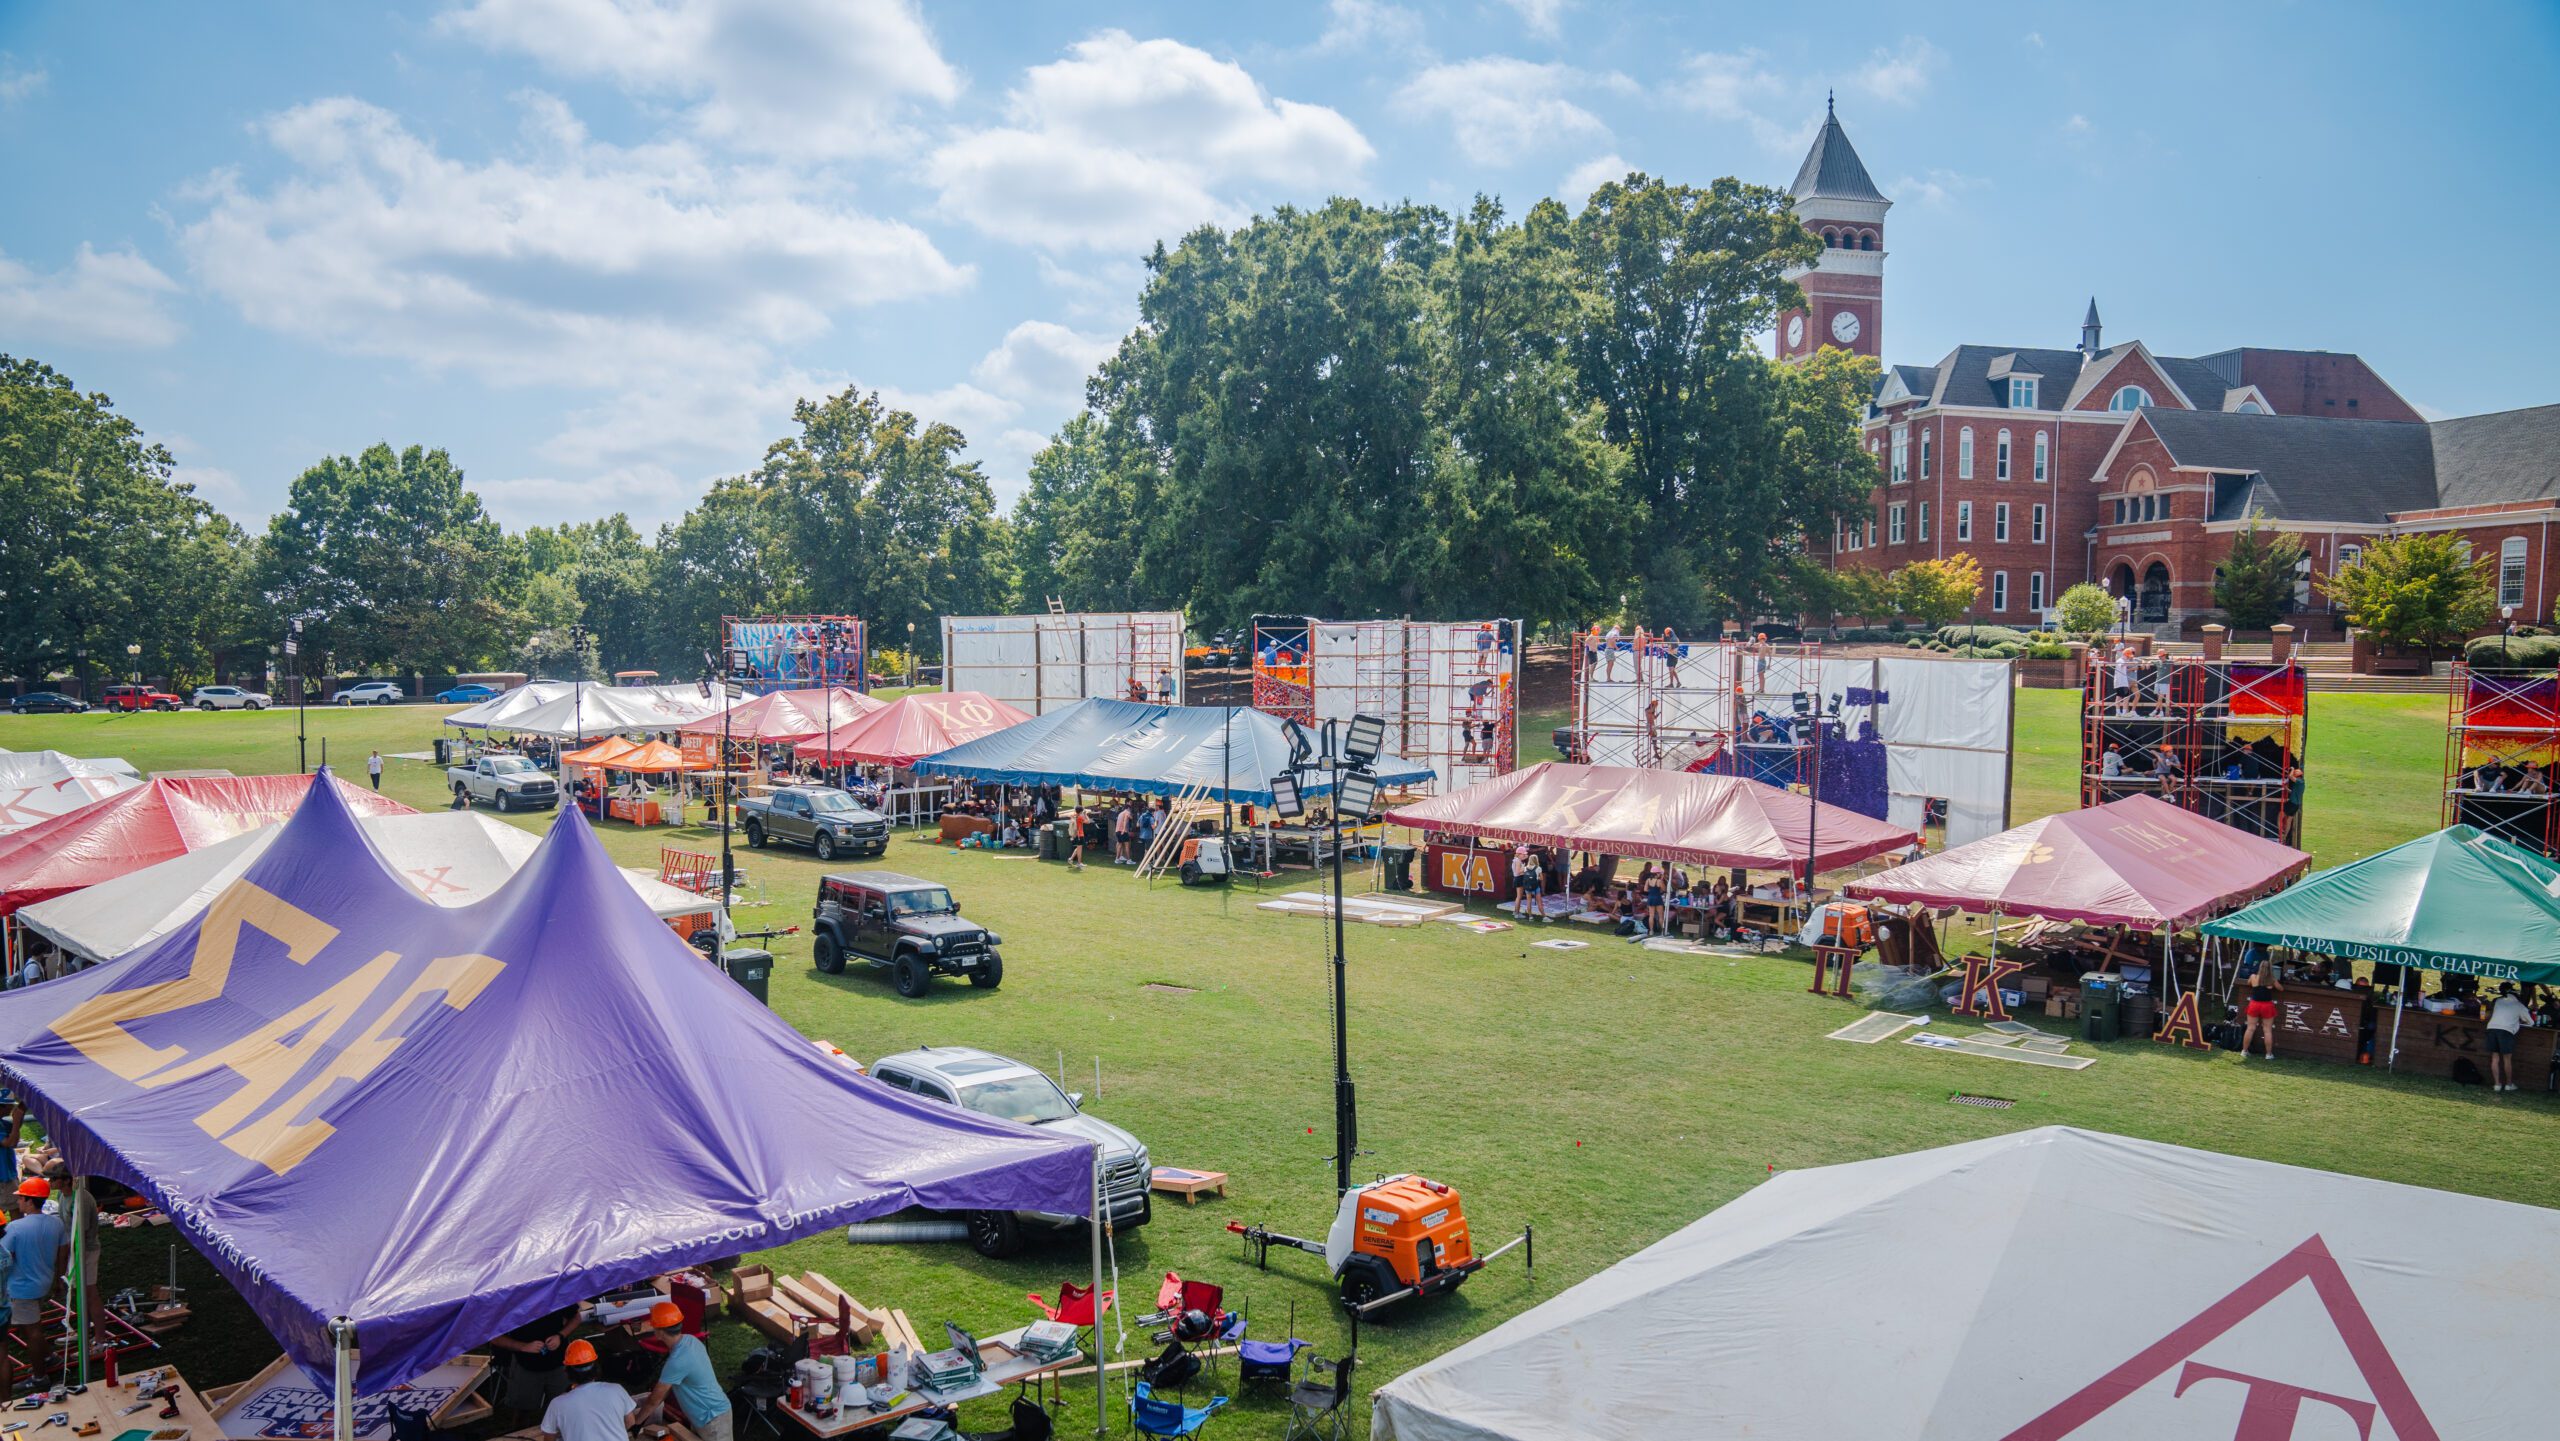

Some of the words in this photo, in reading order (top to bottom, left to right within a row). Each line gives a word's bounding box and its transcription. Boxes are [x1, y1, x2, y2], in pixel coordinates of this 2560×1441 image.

[1440, 821, 1474, 835] KAPPA
[1477, 826, 1515, 842] ALPHA
[1518, 831, 1558, 847] ORDER
[1580, 839, 1638, 856] CLEMSON
[1642, 845, 1720, 866] UNIVERSITY
[1441, 852, 1495, 892] KA
[1984, 900, 2011, 912] PIKE
[2280, 933, 2337, 955] KAPPA
[2345, 942, 2422, 967] UPSILON
[2430, 956, 2520, 980] CHAPTER
[1363, 1236, 1395, 1247] GENERAC
